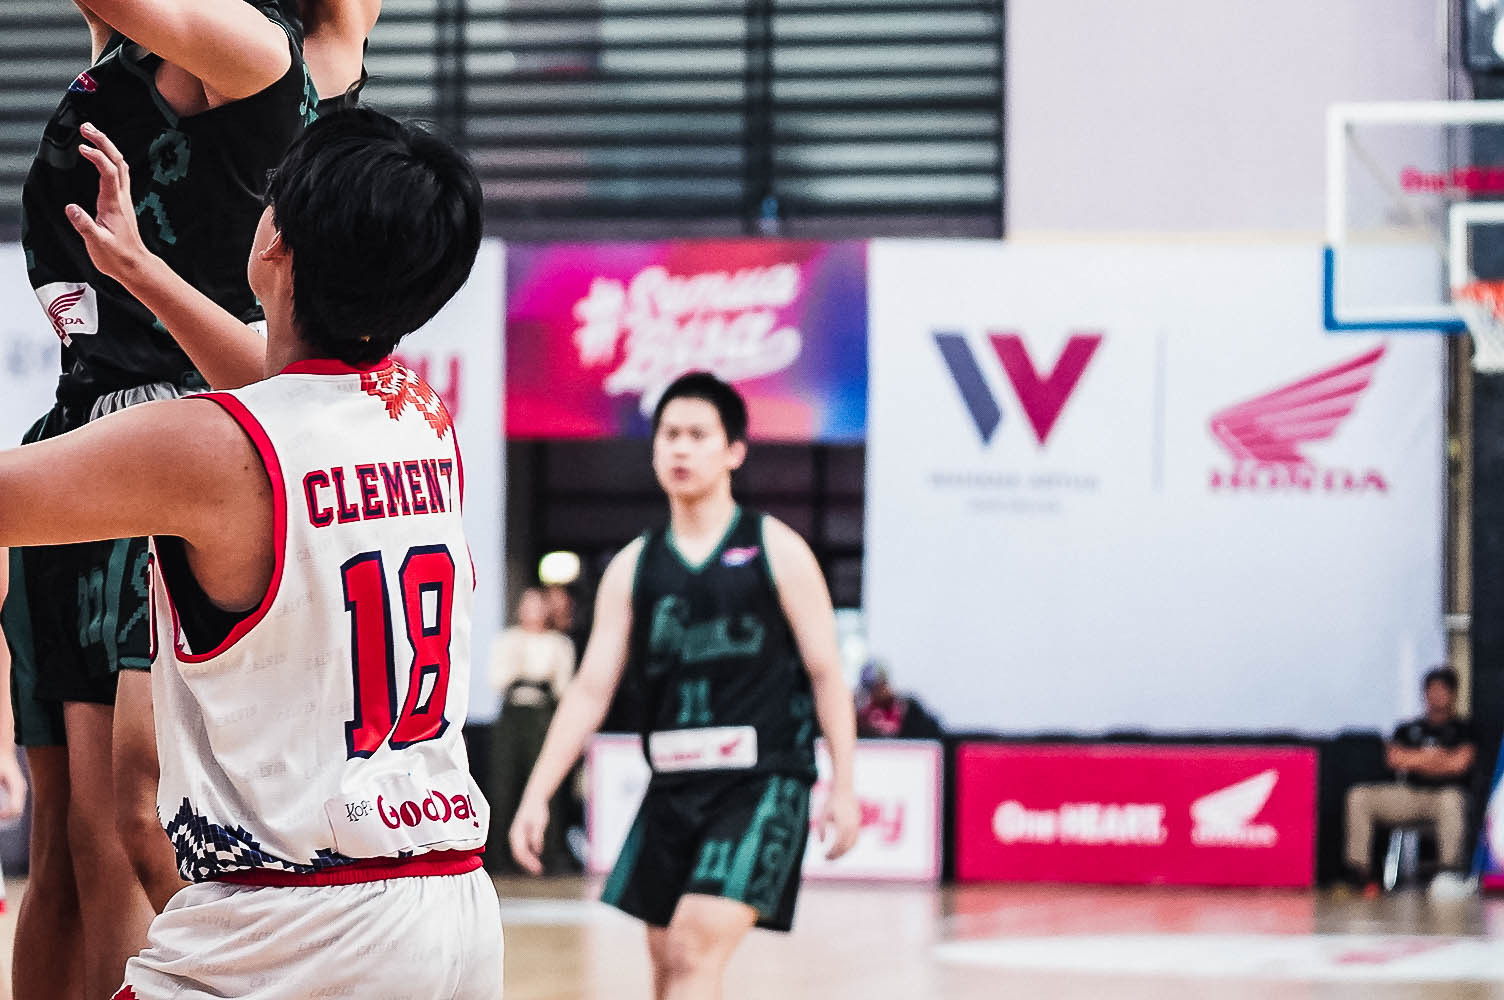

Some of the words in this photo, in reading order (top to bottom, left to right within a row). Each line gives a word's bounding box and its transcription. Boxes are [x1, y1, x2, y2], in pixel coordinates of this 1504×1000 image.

[303, 458, 453, 529] CLEMENT
[1208, 467, 1389, 493] HONDA
[340, 544, 455, 761] 18
